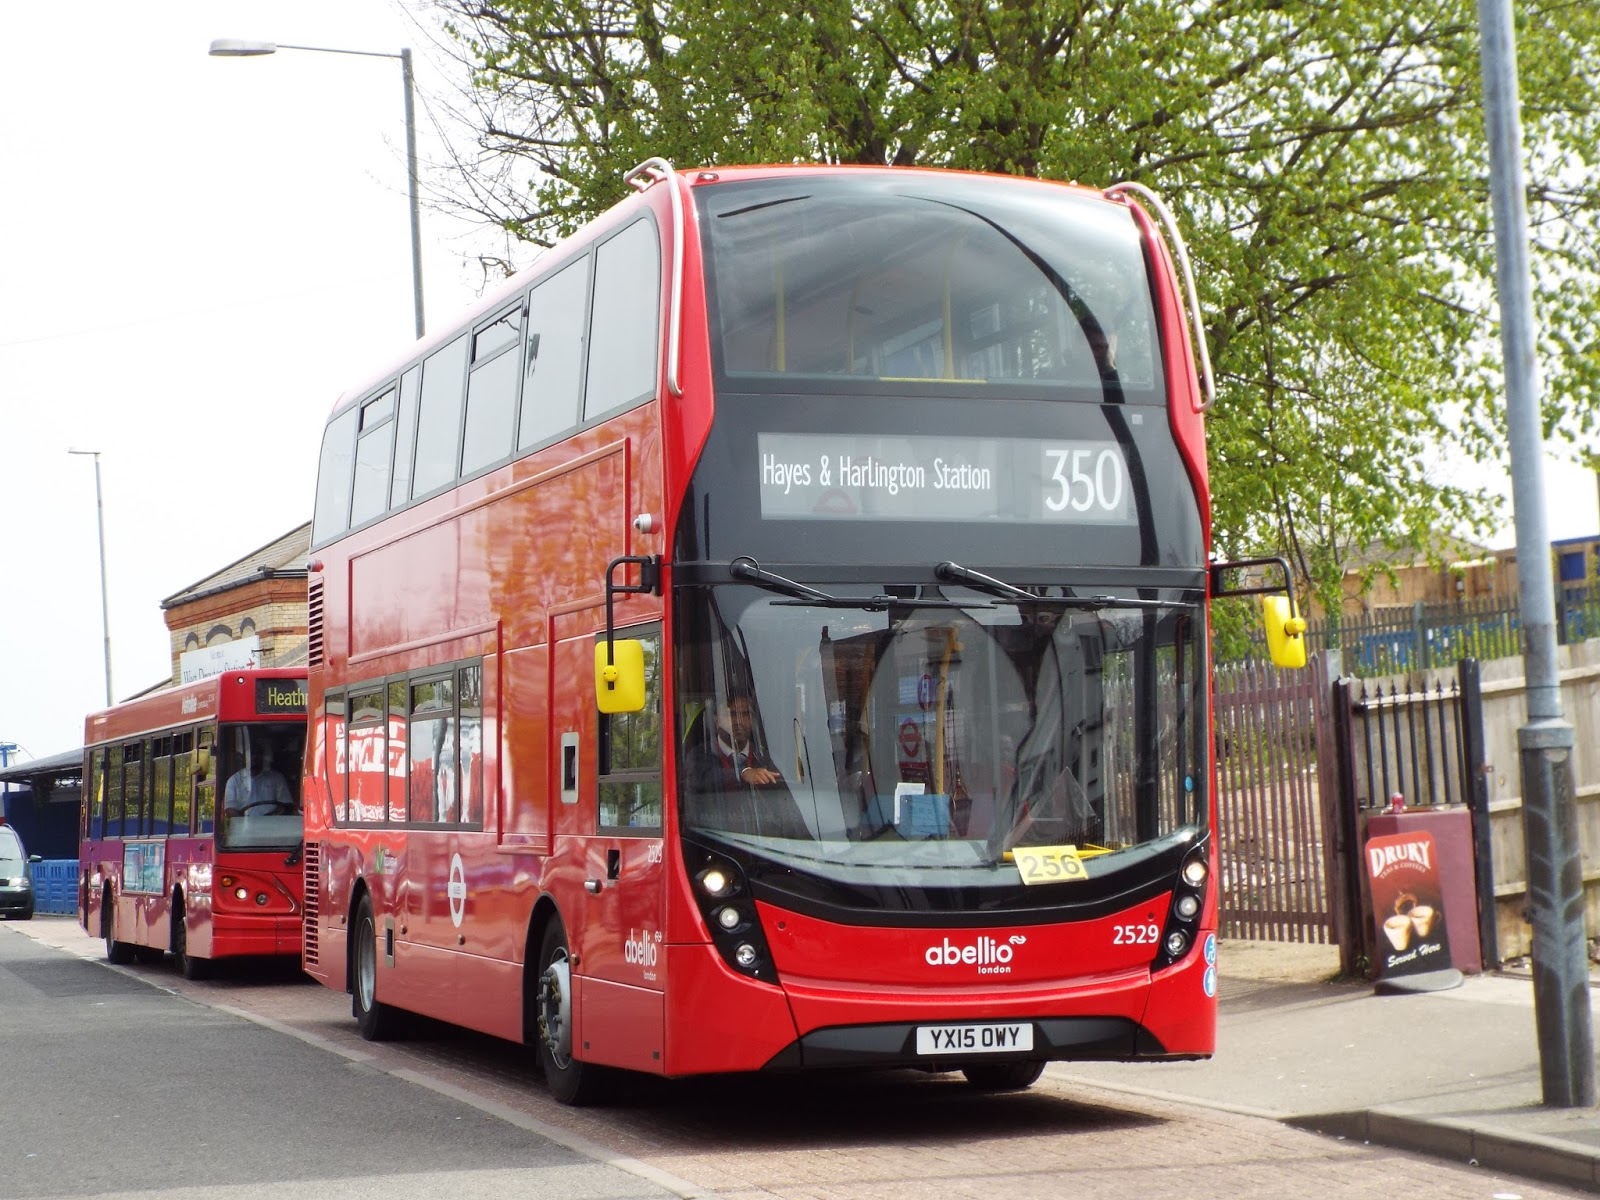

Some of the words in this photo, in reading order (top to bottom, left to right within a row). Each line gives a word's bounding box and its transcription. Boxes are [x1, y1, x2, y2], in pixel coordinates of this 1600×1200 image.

[763, 453, 811, 494] Hayes
[819, 455, 831, 486] &
[839, 456, 925, 495] Harlington
[933, 457, 991, 490] Station
[1045, 448, 1122, 512] 350
[647, 845, 663, 864] 2529
[1021, 854, 1080, 878] 256
[1369, 841, 1431, 877] DRURY
[1113, 924, 1159, 945] 2529
[624, 928, 657, 967] abellio
[925, 936, 1013, 965] abellio
[1388, 949, 1418, 968] Served
[1418, 943, 1441, 956] Here
[643, 969, 657, 981] london
[977, 966, 1011, 974] london
[930, 1028, 976, 1049] YX15
[981, 1027, 1020, 1047] OWY
